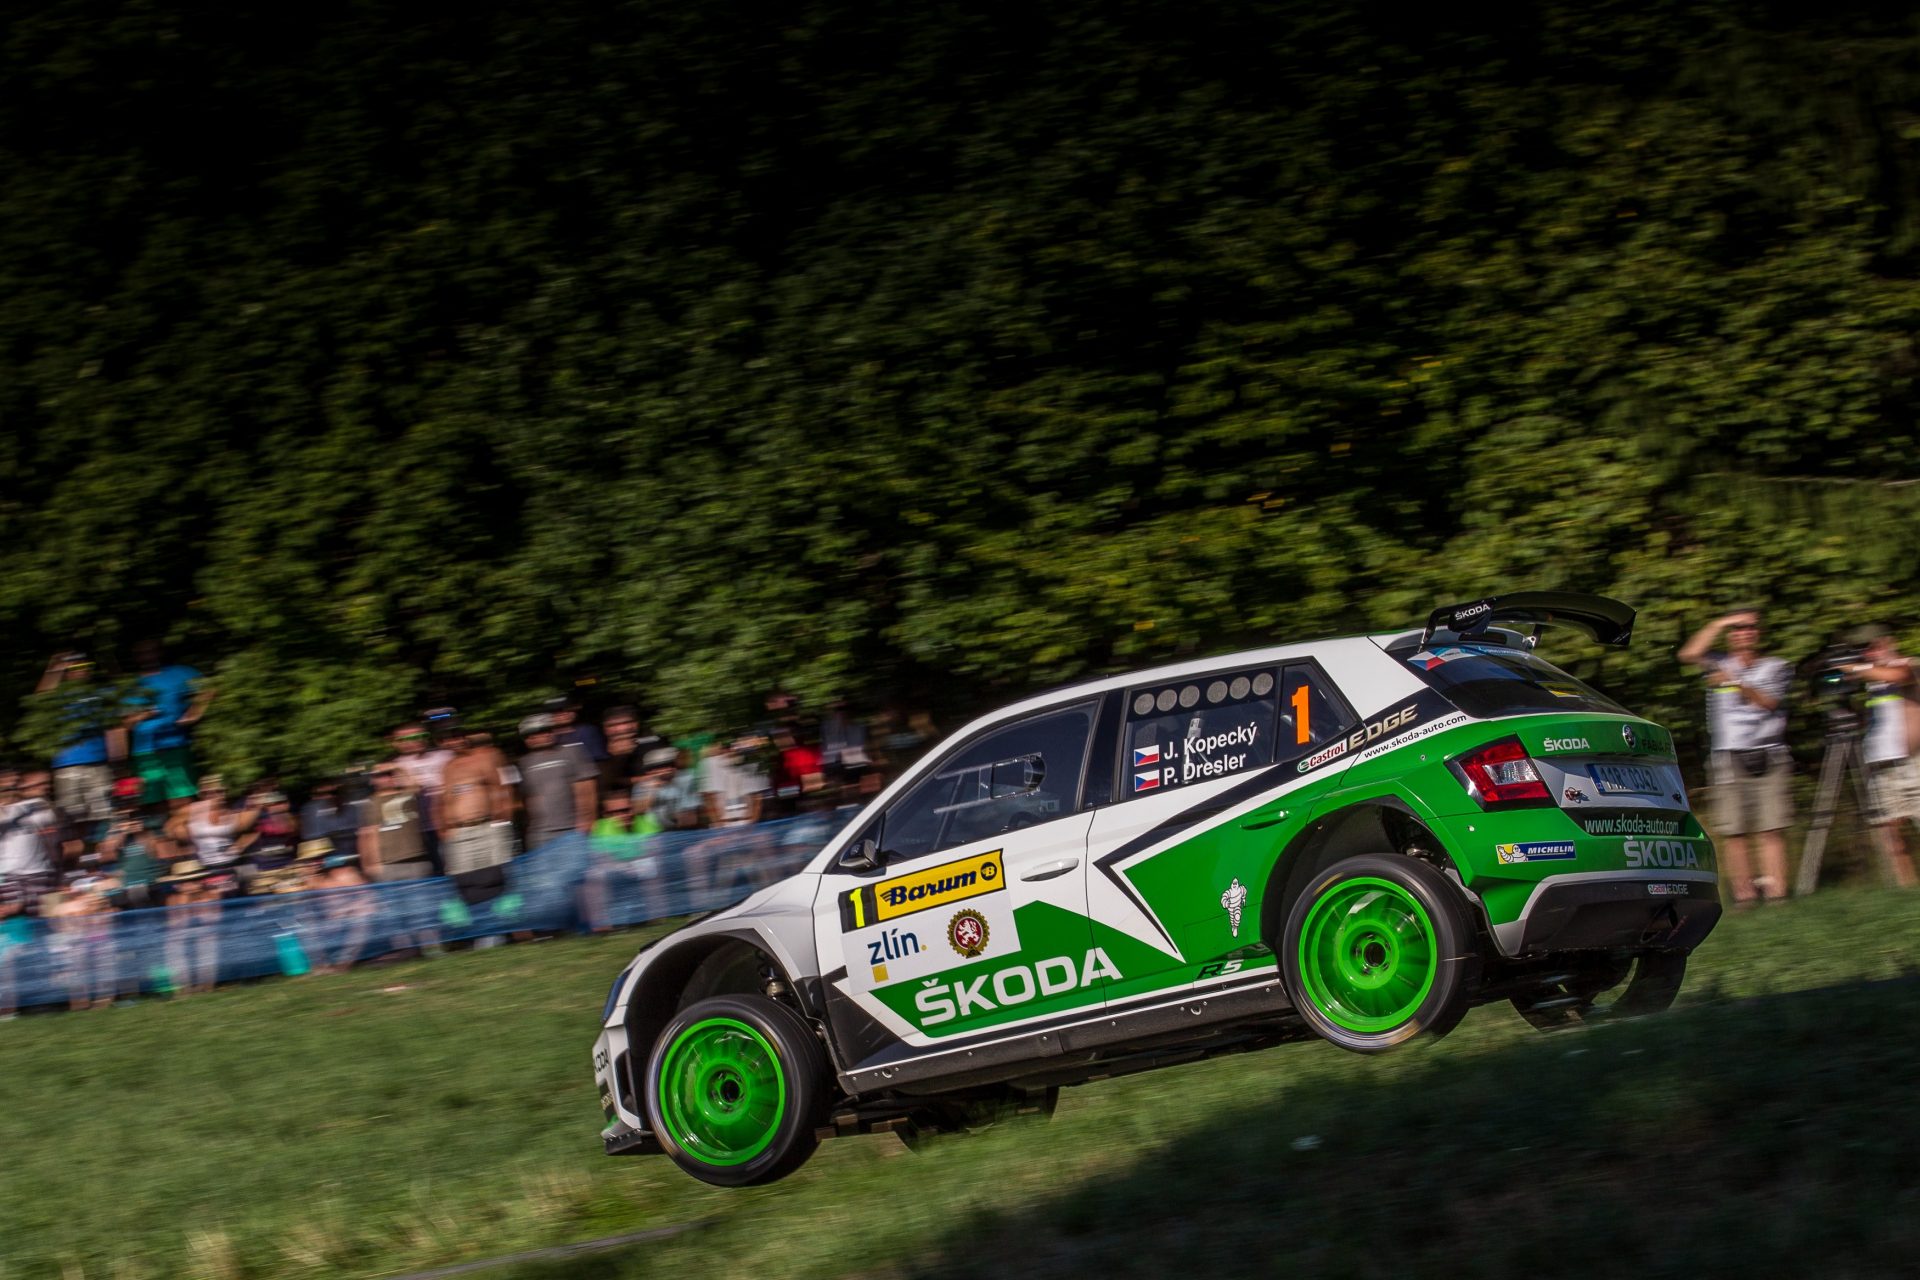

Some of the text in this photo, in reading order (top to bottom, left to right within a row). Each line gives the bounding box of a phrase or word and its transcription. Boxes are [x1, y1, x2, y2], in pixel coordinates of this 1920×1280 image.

[1455, 603, 1491, 620] ŠKODA
[1291, 685, 1311, 745] 1
[1163, 722, 1258, 760] J. Kopecký
[1309, 703, 1418, 767] Castrol EDGE
[1363, 714, 1467, 759] www.skoda-auto.com
[1543, 737, 1590, 752] ŠKODA
[1163, 752, 1247, 785] P. Dresler
[1584, 813, 1679, 835] www.skoda-auto.com
[1527, 845, 1575, 855] MICHELIN
[1623, 835, 1699, 868] ŠKODA
[849, 887, 865, 928] 1
[880, 870, 977, 907] Barum
[1195, 959, 1245, 980] R5
[915, 947, 1124, 1027] ŠKODA
